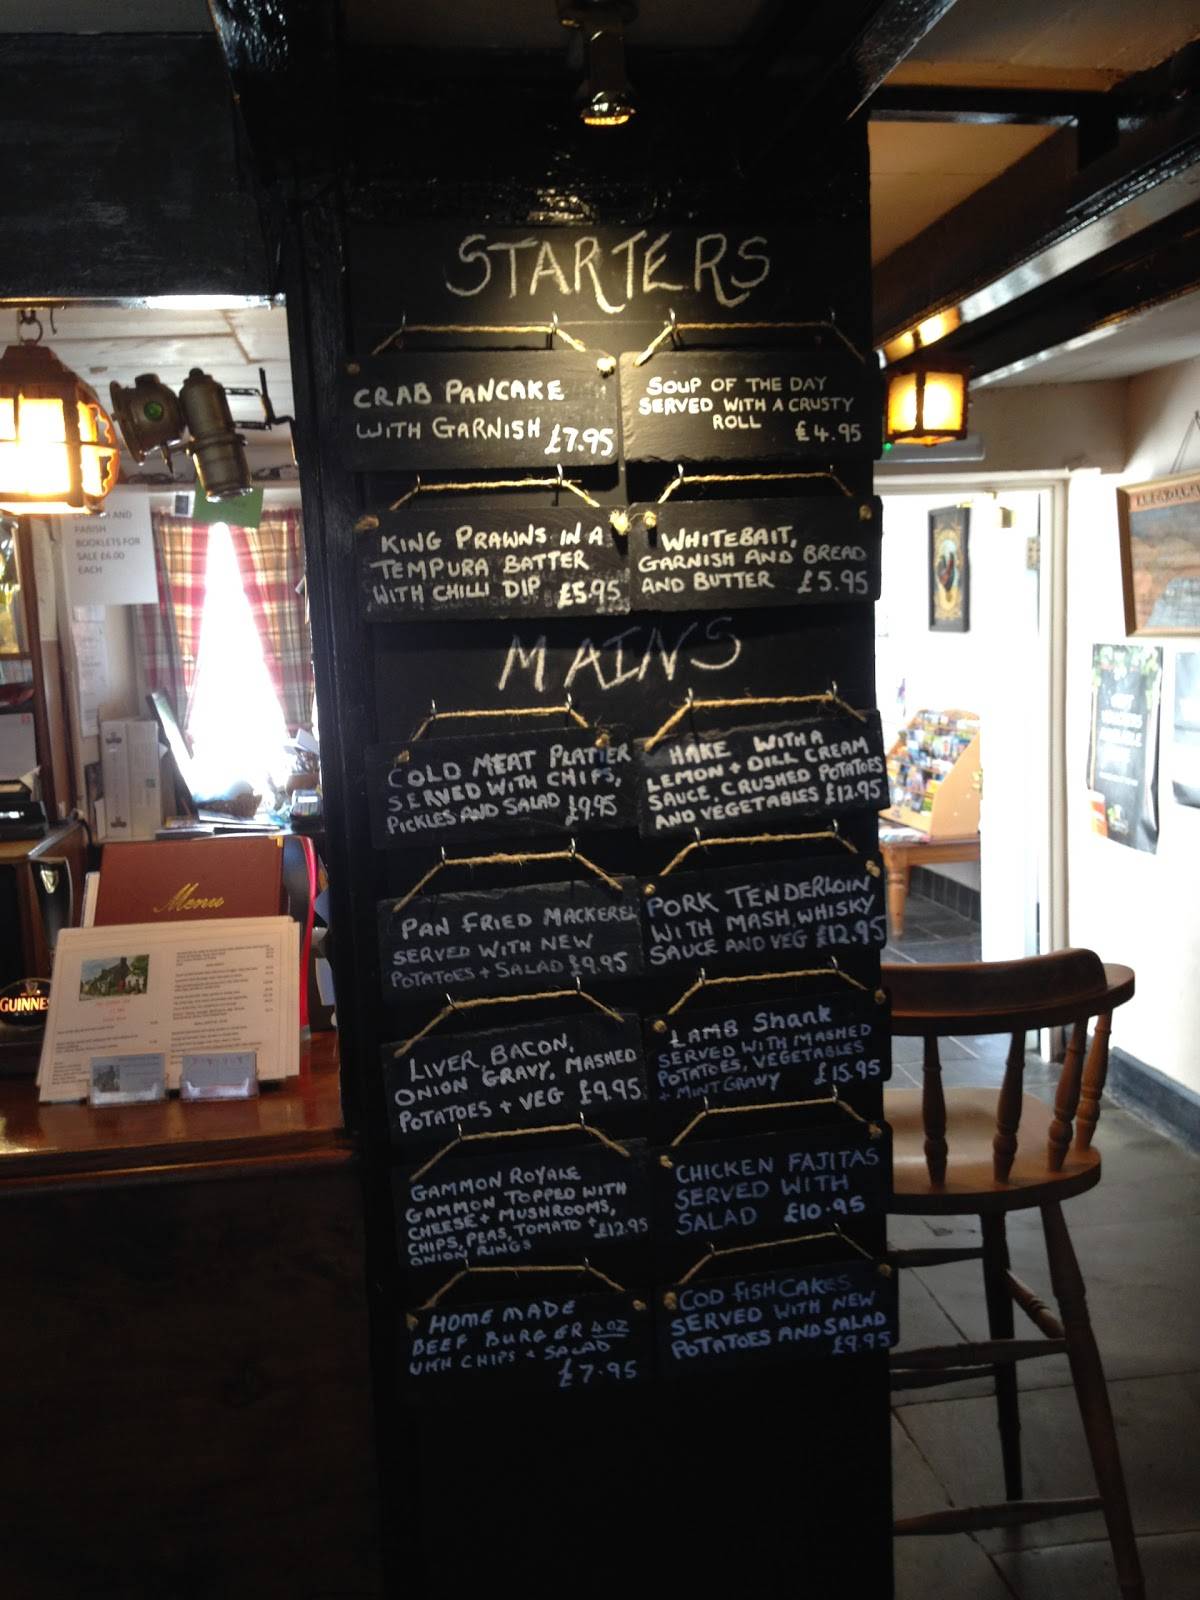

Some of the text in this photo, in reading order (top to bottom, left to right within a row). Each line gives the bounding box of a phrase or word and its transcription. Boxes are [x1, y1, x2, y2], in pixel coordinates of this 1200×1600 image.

[445, 230, 770, 314] STARTERS
[353, 378, 564, 408] CRAB PANCAKE
[646, 377, 827, 395] SOUP OF THE DAY
[639, 397, 854, 415] SERVED WITH A CRUSTY
[713, 415, 761, 430] ROLL
[356, 417, 614, 456] WITH GARNISH £7.95
[795, 421, 862, 442] £4.95
[381, 522, 603, 554] KING PRAWNS IN A
[370, 550, 589, 580] TEMPURA BATTER
[638, 544, 867, 572] GARNISH AND BREAD
[373, 584, 424, 604] WITH
[432, 582, 490, 601] CHILLI
[502, 576, 541, 598] DIP
[557, 579, 621, 608] £5.95
[641, 569, 868, 594] AND BUTTER £5.95
[498, 617, 741, 691] MAINS
[388, 743, 631, 787] COLD MEAT PLATTER
[647, 765, 723, 793] LEMON
[747, 753, 798, 771] DILL
[804, 737, 868, 763] CREAM
[670, 730, 823, 766] HAKE WITH A
[388, 782, 481, 811] SERVED
[486, 775, 537, 796] WITH
[721, 768, 810, 796] CRUSHED
[819, 756, 883, 782] POTATOES
[386, 792, 616, 834] PICKLES AND SALAD £9.95
[655, 779, 882, 829] AND VEGETABLES £12.95
[153, 882, 224, 913] Menu
[647, 875, 870, 917] PORK TENDERLOIN
[401, 905, 637, 940] PAN FRIED MACKEREL
[651, 919, 713, 943] WITH
[798, 895, 875, 923] WHISKY
[393, 933, 593, 965] SERVED WITH NEW
[651, 915, 886, 965] SAUCE AND VEG £12.95
[391, 967, 475, 988] POTATOES
[495, 960, 564, 977] SALAD
[569, 952, 628, 977] £9.95
[0, 997, 48, 1012] GUINNE
[658, 1024, 872, 1068] SERVED WITH MASHED
[670, 1019, 738, 1048] LAMB
[753, 1040, 865, 1069] VEGETABLES
[395, 1077, 468, 1106] ONION
[566, 1049, 637, 1074] MASHED
[677, 1082, 720, 1099] MINT
[724, 1072, 780, 1091] GRAVY
[814, 1059, 880, 1085] £15.95
[399, 1101, 492, 1133] POTATOES
[519, 1087, 564, 1111] VEG
[580, 1078, 641, 1105] £9.95
[676, 1147, 879, 1184] CHICKEN FAJITAS
[411, 1166, 581, 1202] GAMMON ROYALE
[675, 1174, 849, 1211] SERVED WITH
[406, 1182, 626, 1224] GAMMON TOPPED WITH
[676, 1195, 865, 1235] SALAD £10.95
[408, 1214, 477, 1240] CHEESE
[513, 1220, 581, 1237] TOMATO
[594, 1218, 648, 1239] £12.95
[411, 1239, 532, 1266] ONION RINGS
[429, 1300, 576, 1334] HOME MADE
[671, 1290, 875, 1336] SERVED WITH NEW
[680, 1289, 724, 1311] COD
[412, 1334, 468, 1356] BEEF
[671, 1312, 886, 1360] POTATOES AND SALAD
[831, 1331, 891, 1355] £9.95
[461, 1350, 515, 1369] CHIPS
[558, 1358, 637, 1387] £7.95
